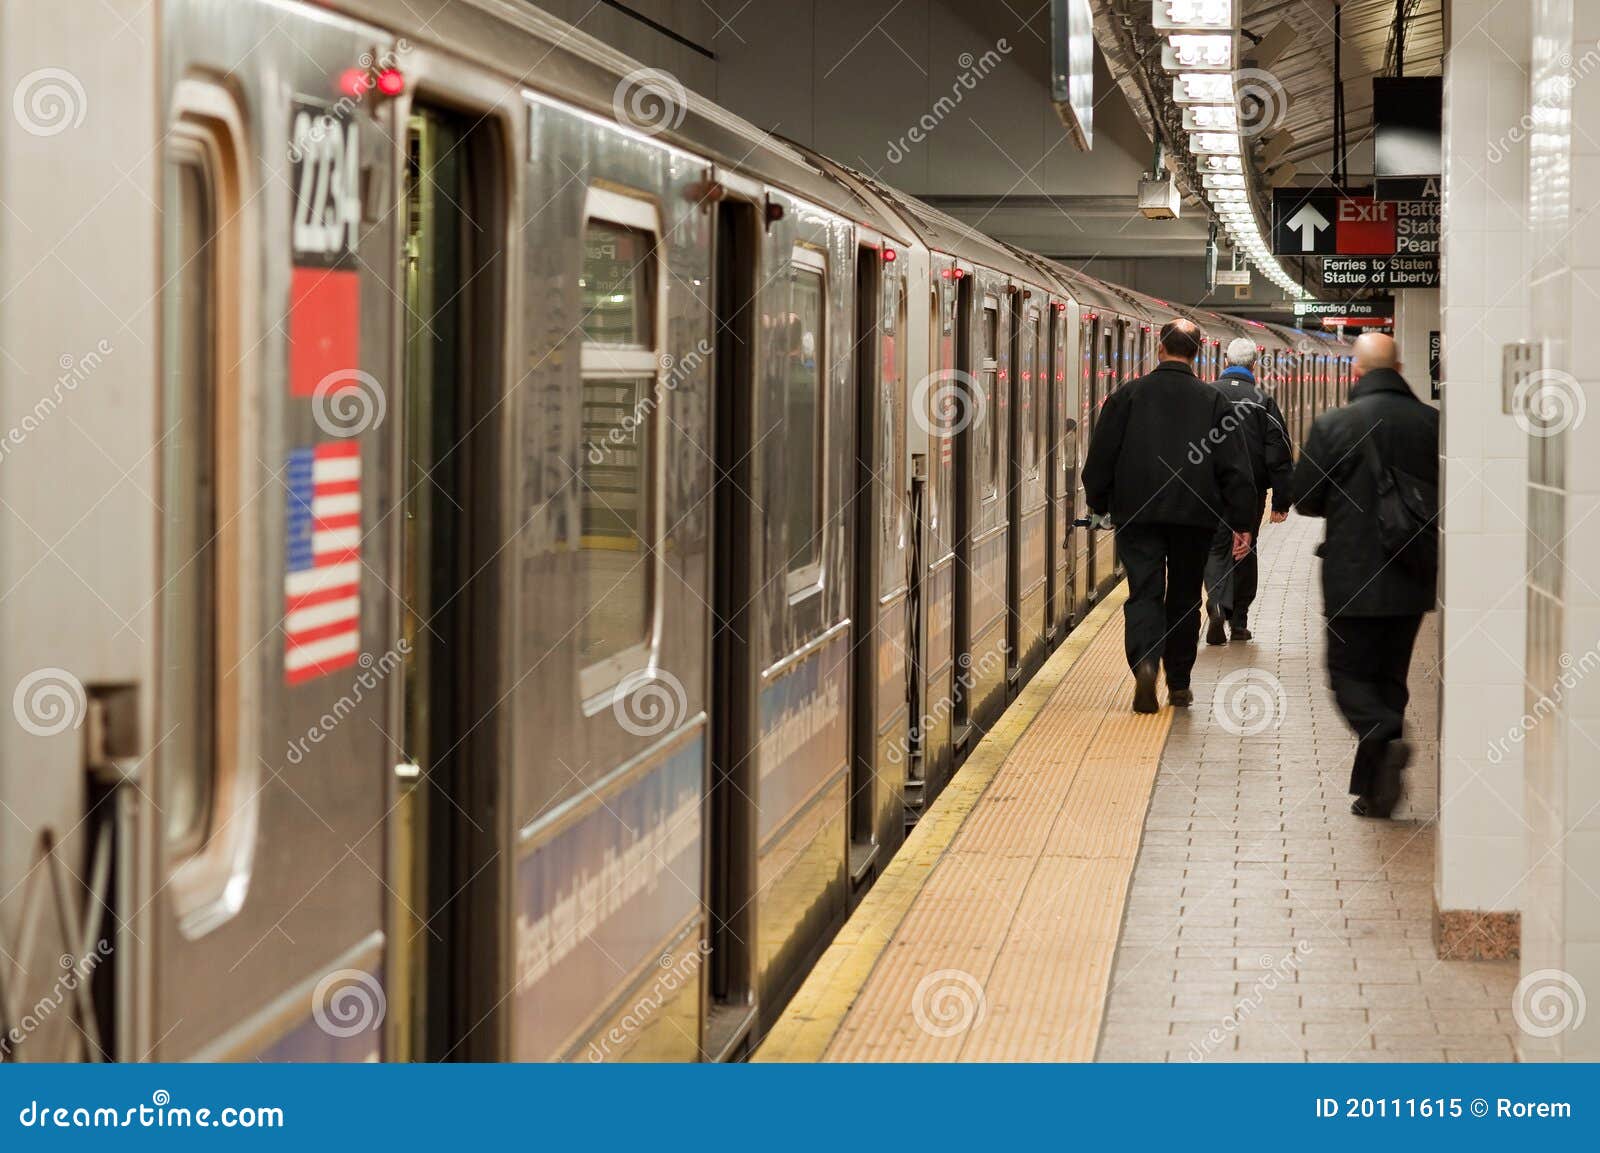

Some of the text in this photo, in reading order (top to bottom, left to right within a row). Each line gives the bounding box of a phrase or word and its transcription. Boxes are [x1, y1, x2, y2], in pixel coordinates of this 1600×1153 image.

[1422, 178, 1441, 198] A
[1339, 200, 1388, 222] Exit
[1323, 259, 1367, 270] Ferries
[1372, 259, 1386, 270] to
[1390, 259, 1433, 270] Staten
[1323, 271, 1366, 283] Statue
[1371, 271, 1385, 283] of
[1305, 303, 1372, 314] Boarding Area
